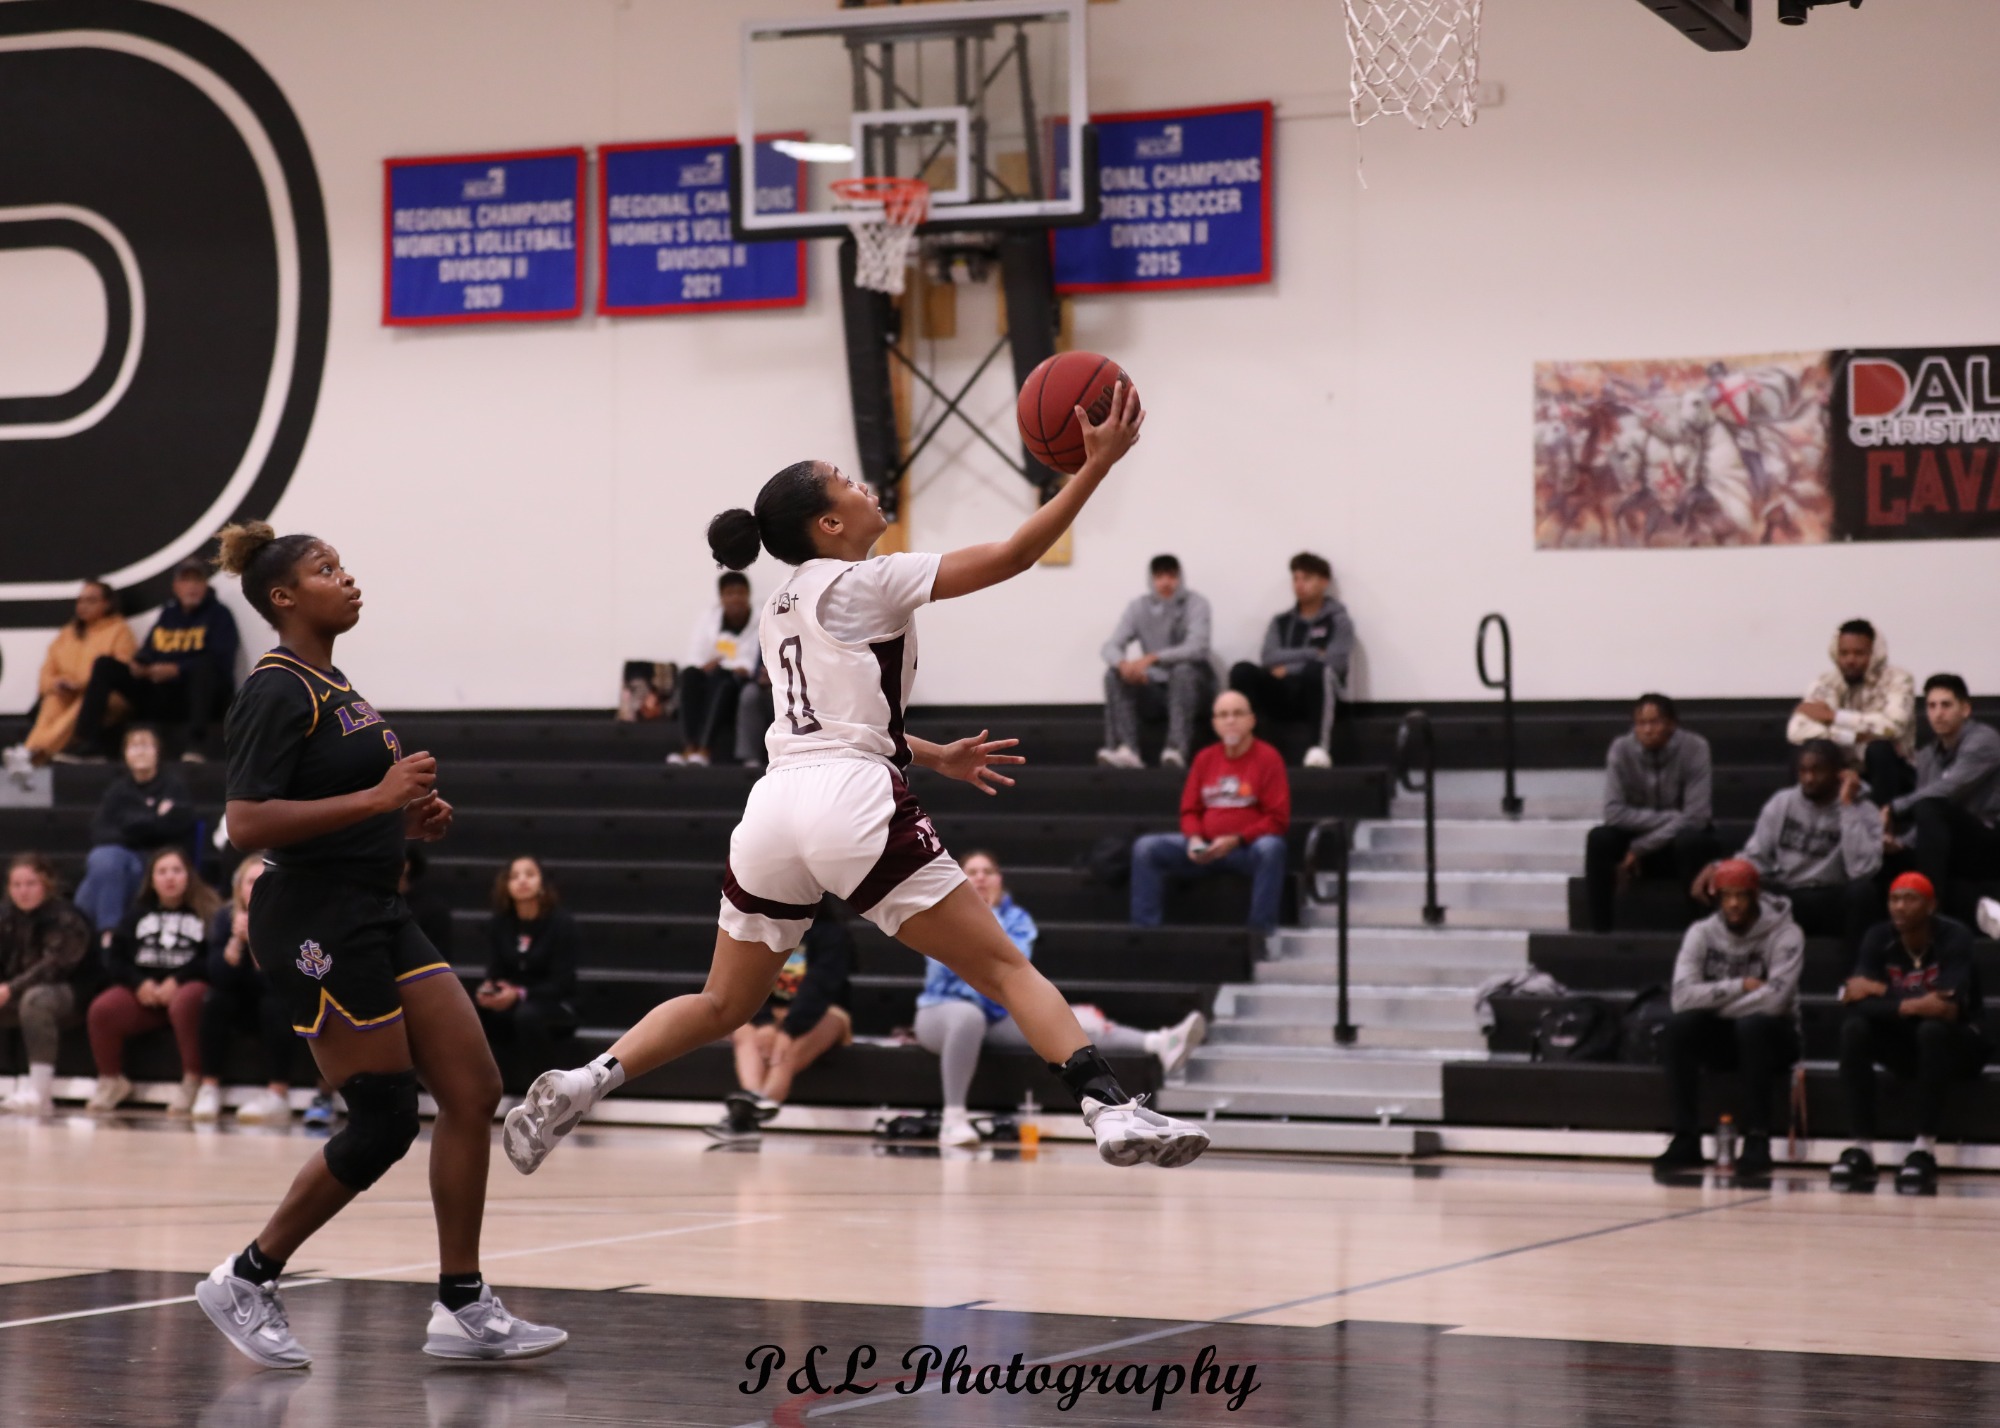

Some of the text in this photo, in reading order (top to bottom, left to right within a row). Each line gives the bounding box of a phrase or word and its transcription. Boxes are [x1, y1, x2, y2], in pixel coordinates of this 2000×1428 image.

[1152, 157, 1261, 189] CHAMPIONS
[476, 199, 573, 228] CHAMPIONS
[1169, 188, 1242, 217] SOCCER
[474, 227, 574, 254] VOLLEYBALL
[1111, 221, 1191, 248] DIVISION
[439, 256, 512, 283] DIVISION
[657, 246, 730, 272] DIVISION
[1136, 250, 1181, 277] 2015
[1848, 414, 2000, 448] CHRISTIA
